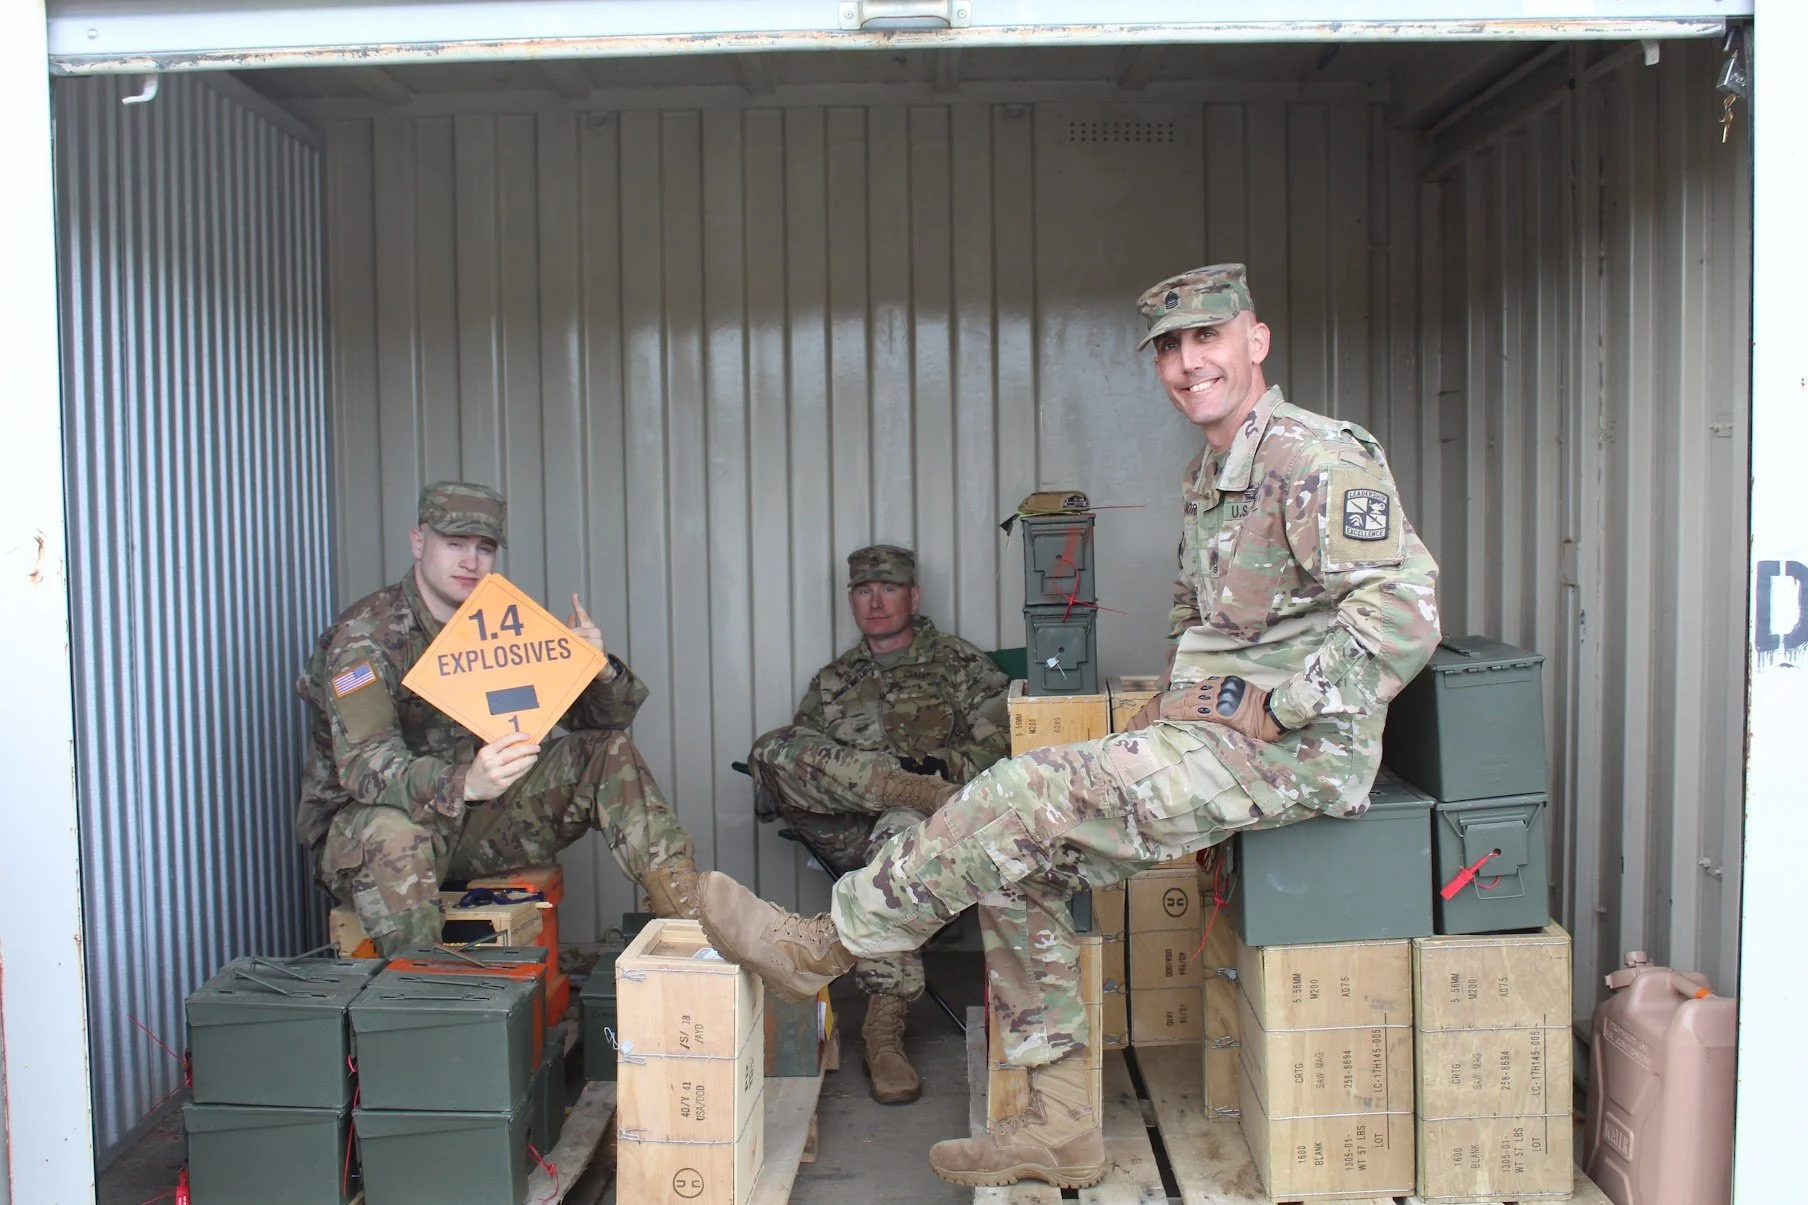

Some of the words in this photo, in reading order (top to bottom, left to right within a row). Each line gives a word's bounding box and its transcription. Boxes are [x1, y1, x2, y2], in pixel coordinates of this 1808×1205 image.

[1349, 490, 1387, 501] LEADERSHIP
[1346, 528, 1384, 538] EXCELLENCE
[1755, 560, 1808, 650] D
[468, 604, 524, 641] 1.4
[437, 637, 572, 677] EXPLOSIVES
[508, 715, 520, 733] 1
[1310, 979, 1320, 1000] M200
[1340, 976, 1350, 998] A075
[1468, 979, 1478, 1000] M200
[1499, 976, 1509, 998] A075
[1314, 1052, 1324, 1068] MAG
[1294, 1063, 1304, 1084] CRTG
[1316, 1072, 1325, 1089] SAW
[1452, 1063, 1461, 1085] CRTG
[696, 1085, 705, 1121] USA/DOD
[1356, 1126, 1366, 1141] LBS
[1374, 1133, 1384, 1148] LOT
[1514, 1128, 1524, 1142] LBS
[1314, 1142, 1324, 1166] BLANK
[1357, 1146, 1366, 1155] 57
[1514, 1148, 1524, 1157] 57
[1532, 1137, 1542, 1152] LOT
[1297, 1145, 1306, 1164] 1600
[1453, 1147, 1462, 1166] 1600
[1471, 1144, 1480, 1169] BLANK
[1357, 1160, 1367, 1172] WT
[1514, 1162, 1524, 1174] WT
